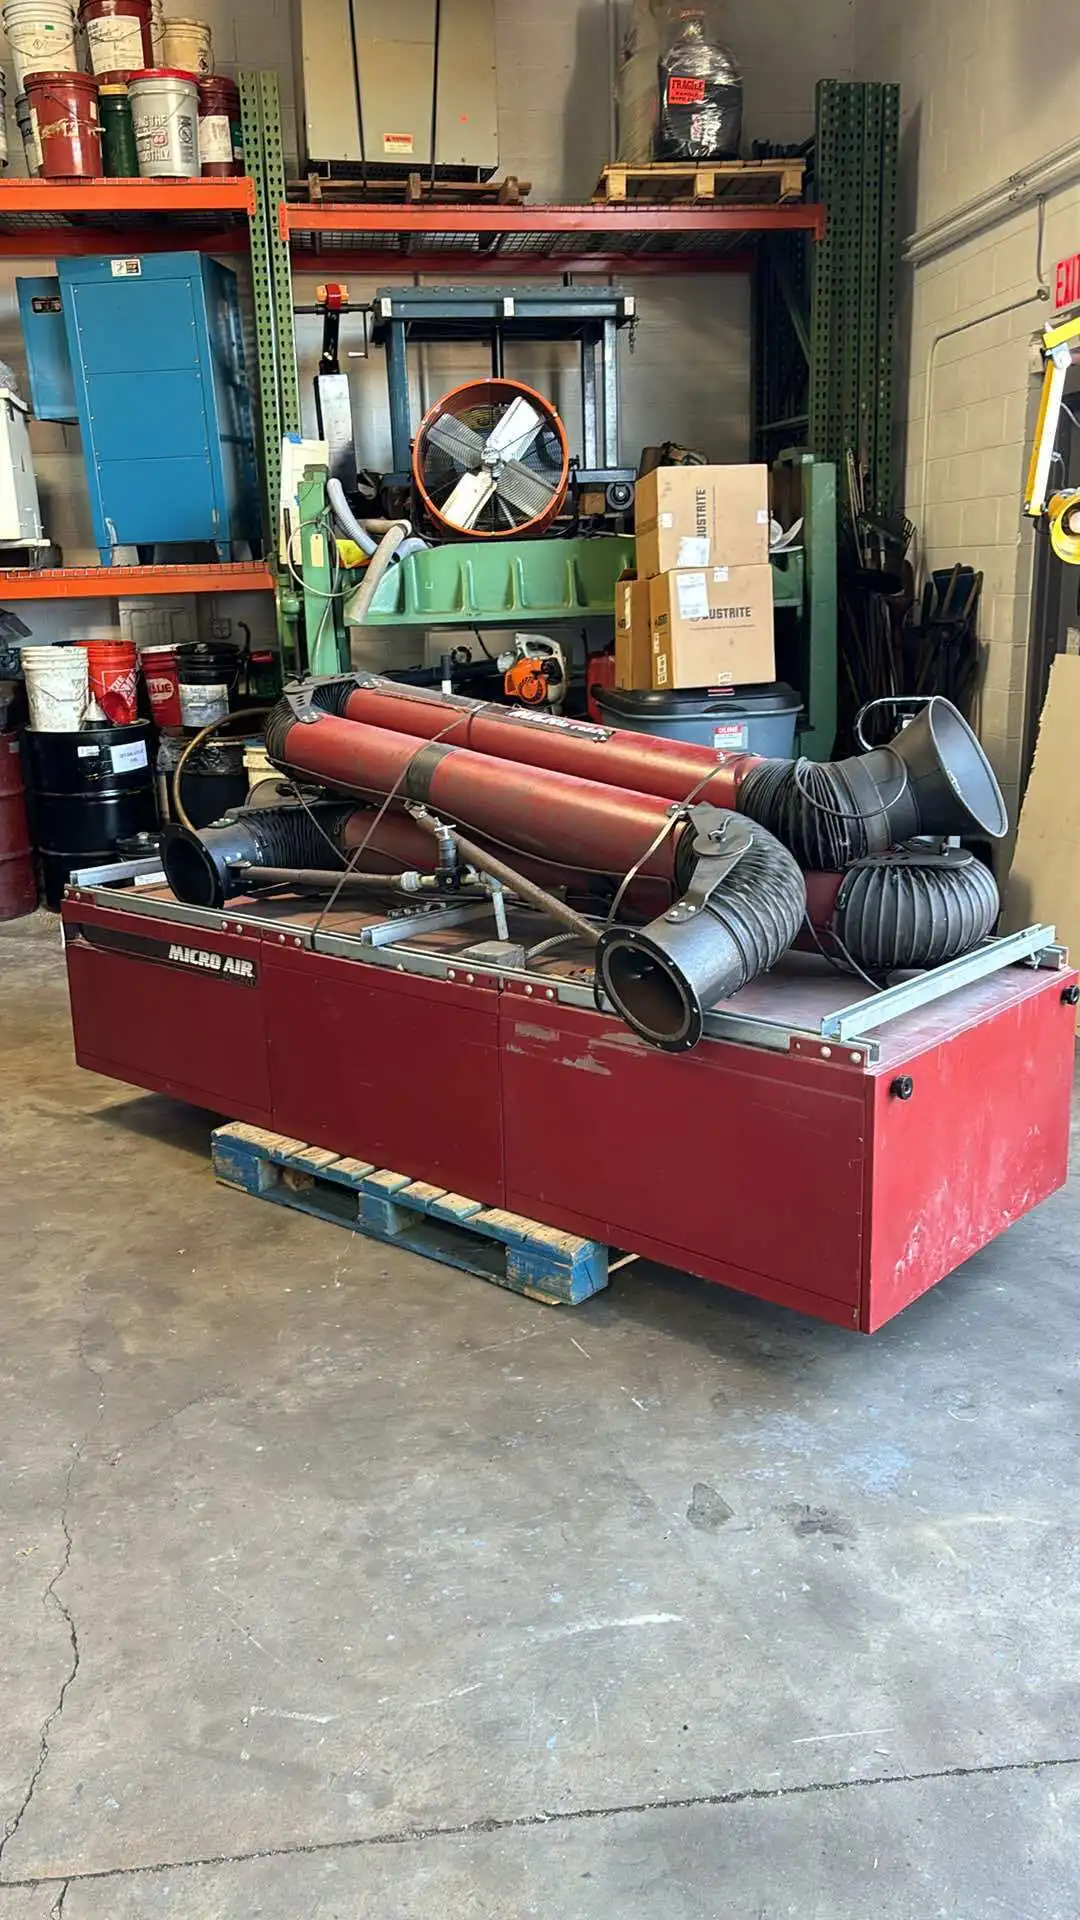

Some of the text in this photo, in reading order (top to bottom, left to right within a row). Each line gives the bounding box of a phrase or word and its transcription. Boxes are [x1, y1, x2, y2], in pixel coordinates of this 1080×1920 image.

[702, 606, 752, 620] USTRITE
[168, 943, 256, 978] MICRO AIR
